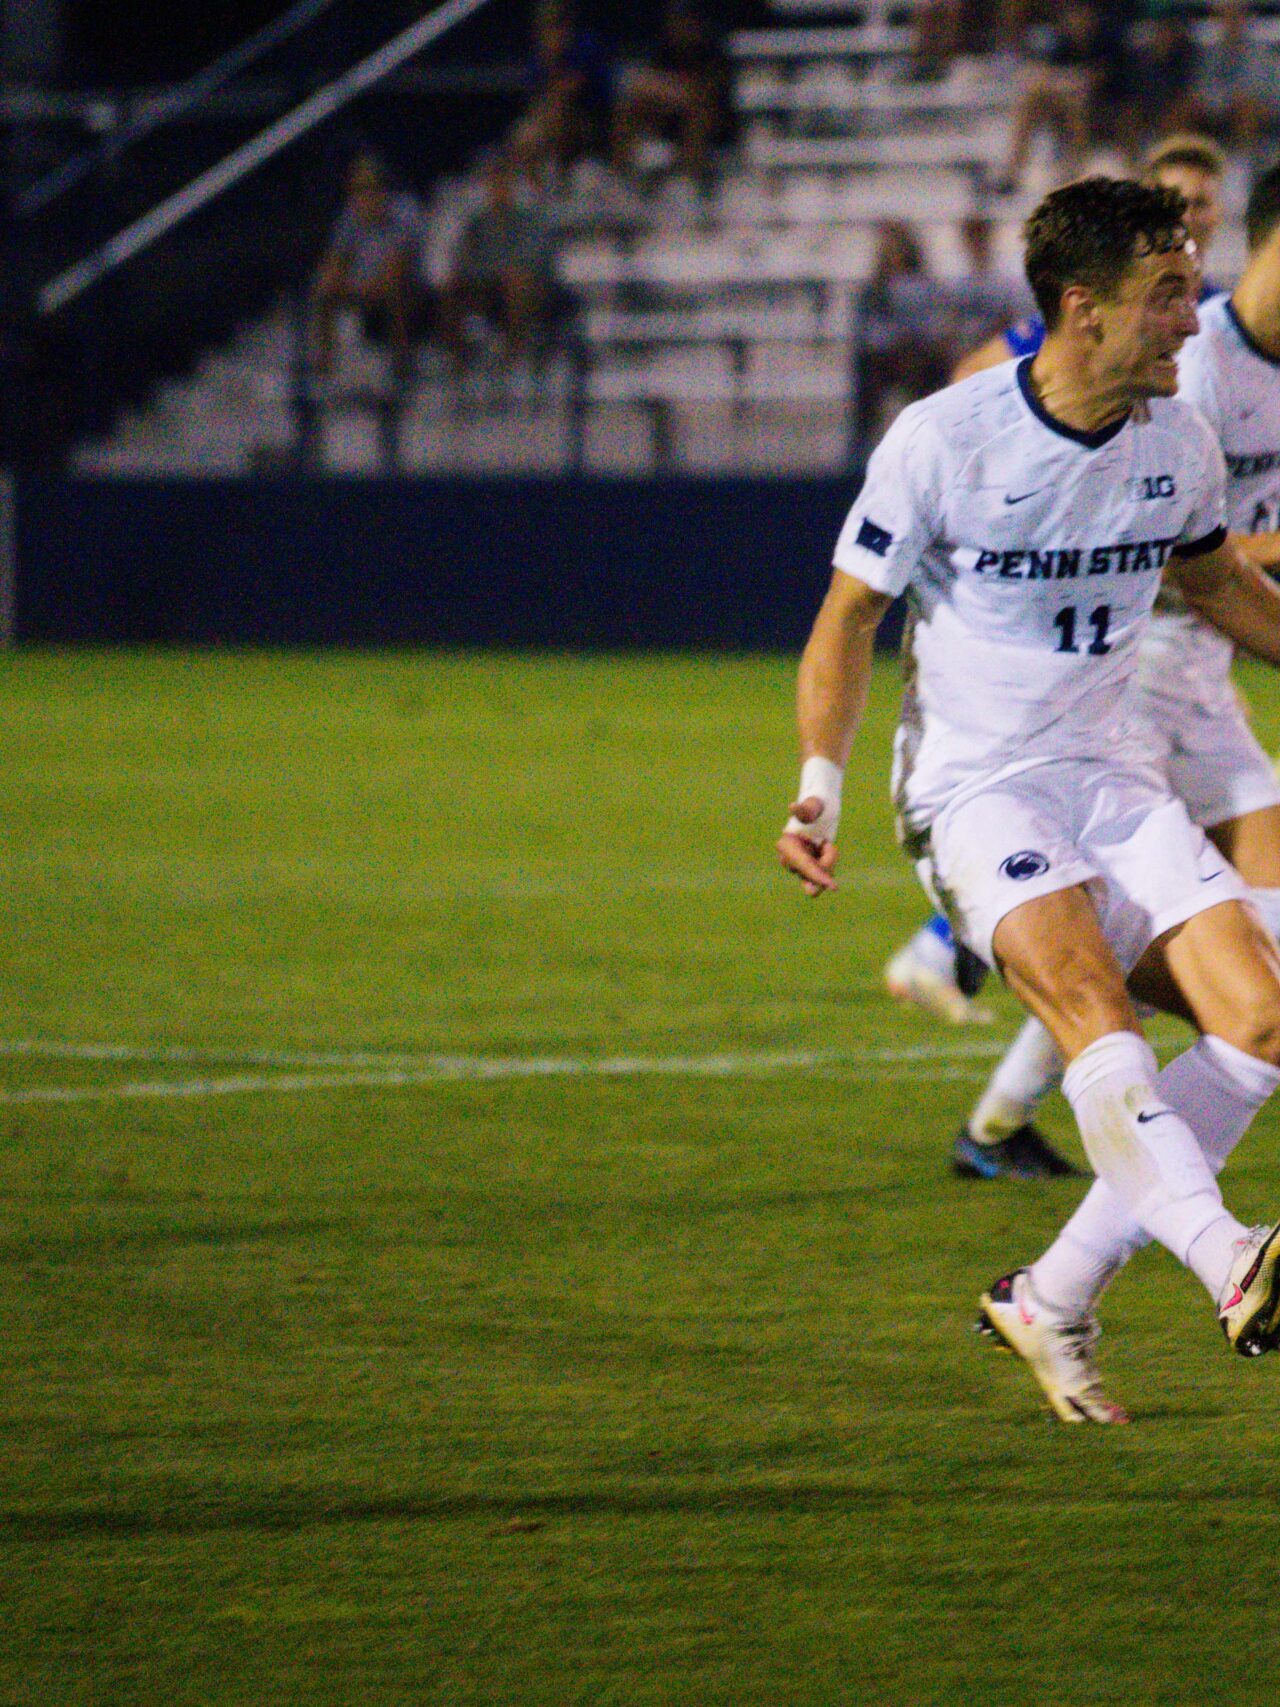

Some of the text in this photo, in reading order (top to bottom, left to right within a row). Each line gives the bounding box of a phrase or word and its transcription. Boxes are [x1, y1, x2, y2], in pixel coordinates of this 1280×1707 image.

[1124, 475, 1177, 500] 1G
[974, 537, 1173, 579] PENN STAT
[1053, 605, 1112, 655] 11
